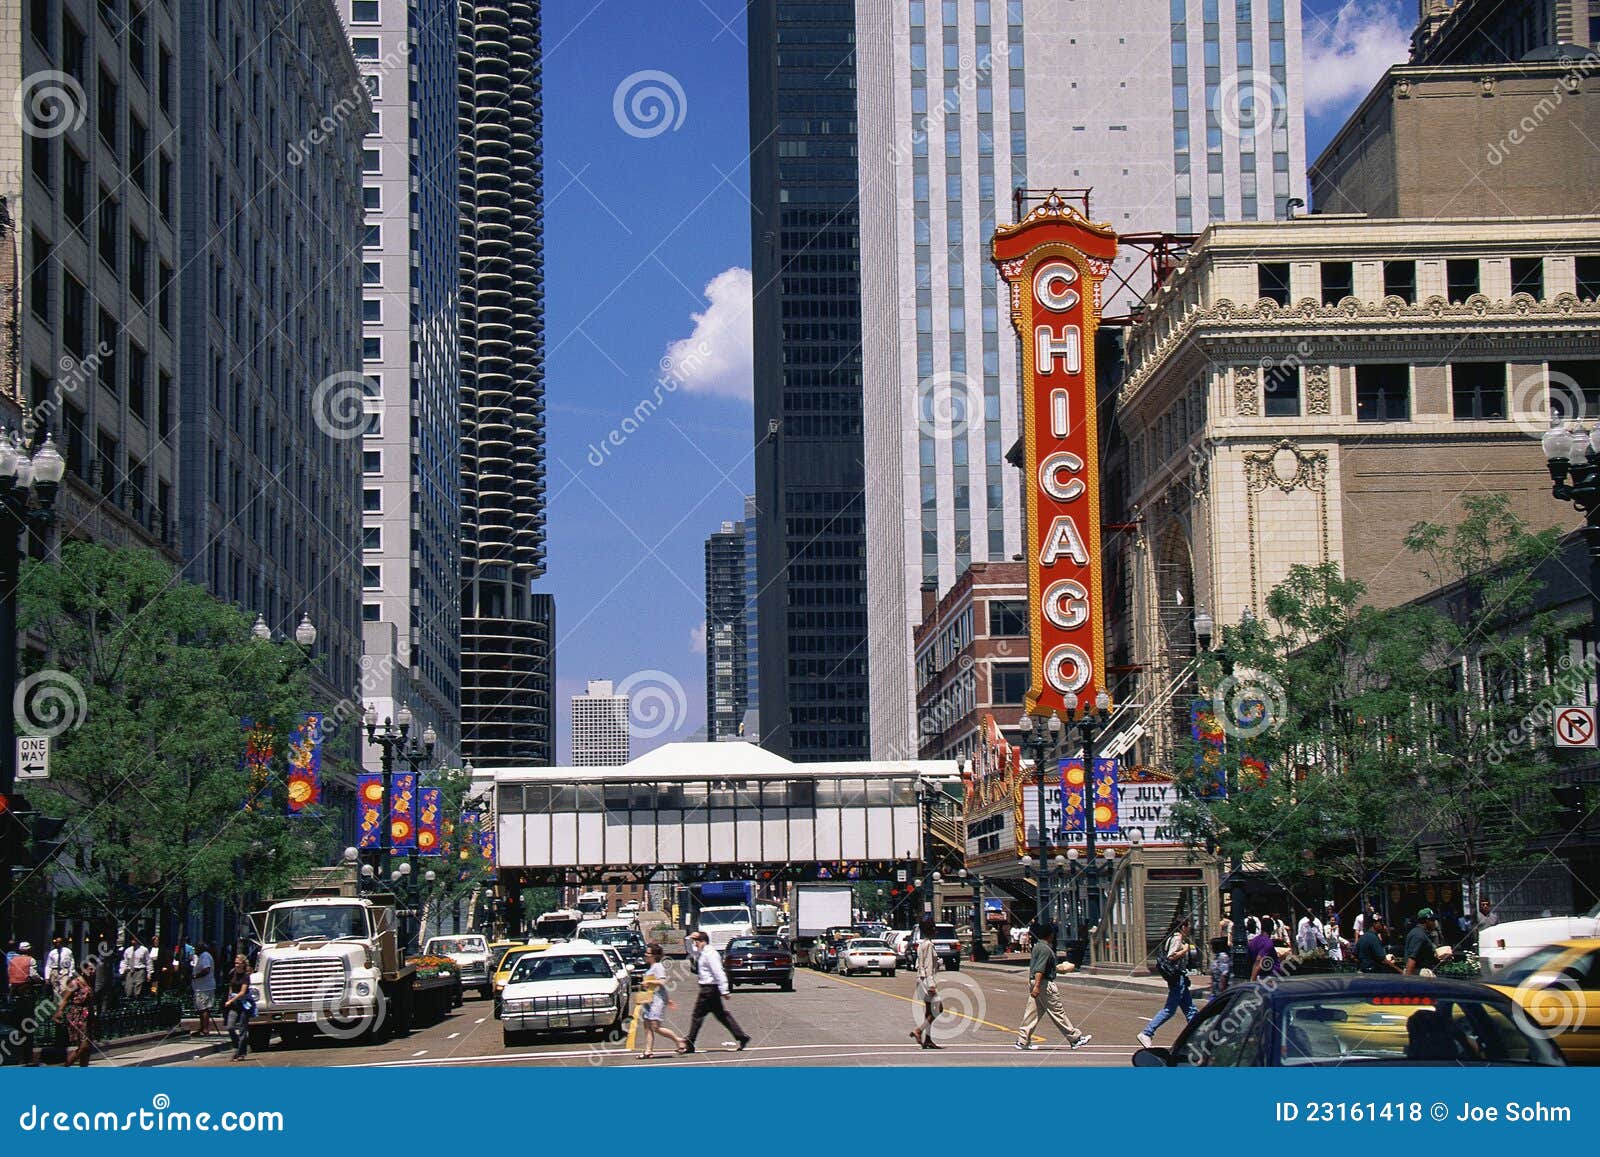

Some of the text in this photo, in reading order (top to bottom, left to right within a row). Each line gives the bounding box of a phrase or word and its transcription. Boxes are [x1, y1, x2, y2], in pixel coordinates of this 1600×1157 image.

[1033, 262, 1092, 694] CHICAGO
[21, 740, 46, 750] ONE
[21, 751, 46, 761] WAY
[1134, 787, 1167, 801] JULY
[1128, 806, 1161, 821] JULY
